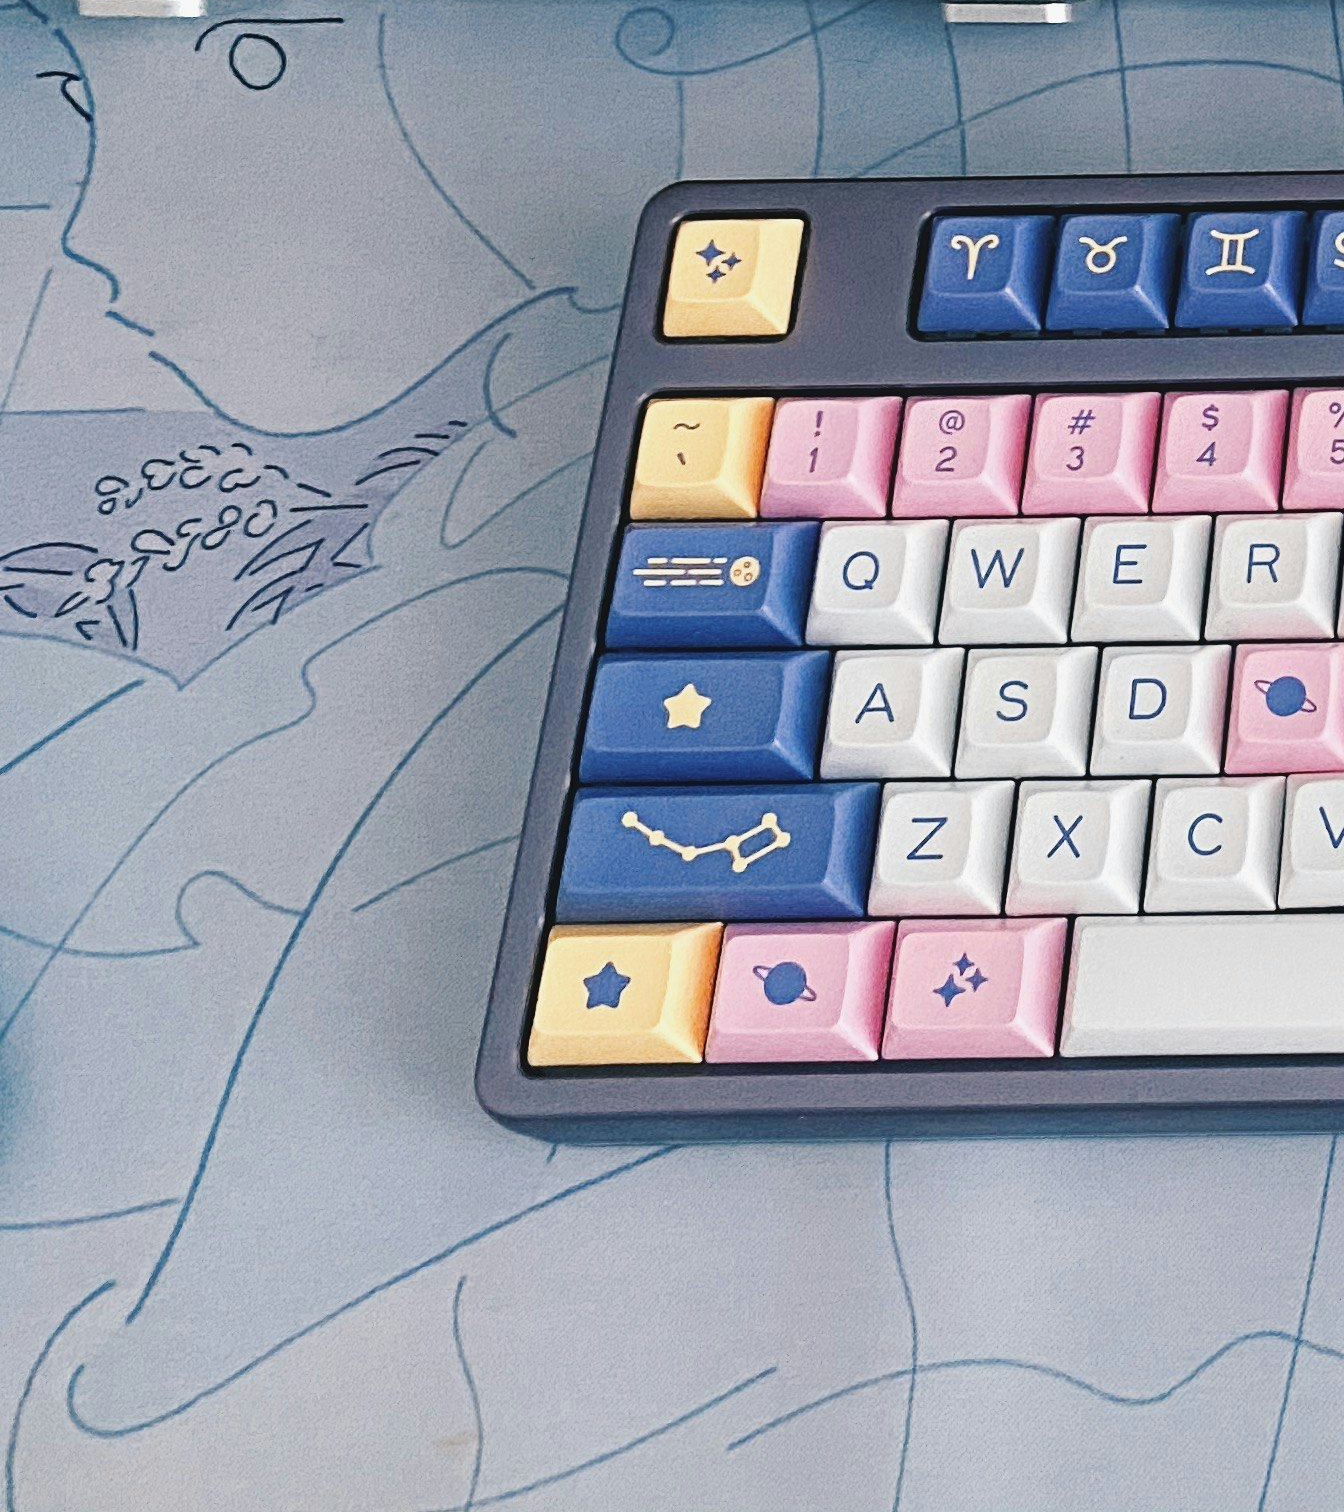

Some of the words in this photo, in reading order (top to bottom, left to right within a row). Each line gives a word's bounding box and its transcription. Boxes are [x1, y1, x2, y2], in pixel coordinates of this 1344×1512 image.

[809, 446, 819, 474] 1
[934, 445, 958, 473] 2
[1065, 445, 1085, 472] 3
[1195, 441, 1217, 467] 4
[842, 551, 880, 591] Q
[970, 547, 1025, 589] W
[1112, 543, 1148, 585] E
[1246, 543, 1281, 584] R
[854, 682, 895, 725] A
[996, 680, 1029, 722] S
[1128, 678, 1167, 720] D
[906, 816, 948, 861] Z
[1046, 814, 1084, 859] X
[1187, 812, 1223, 856] C
